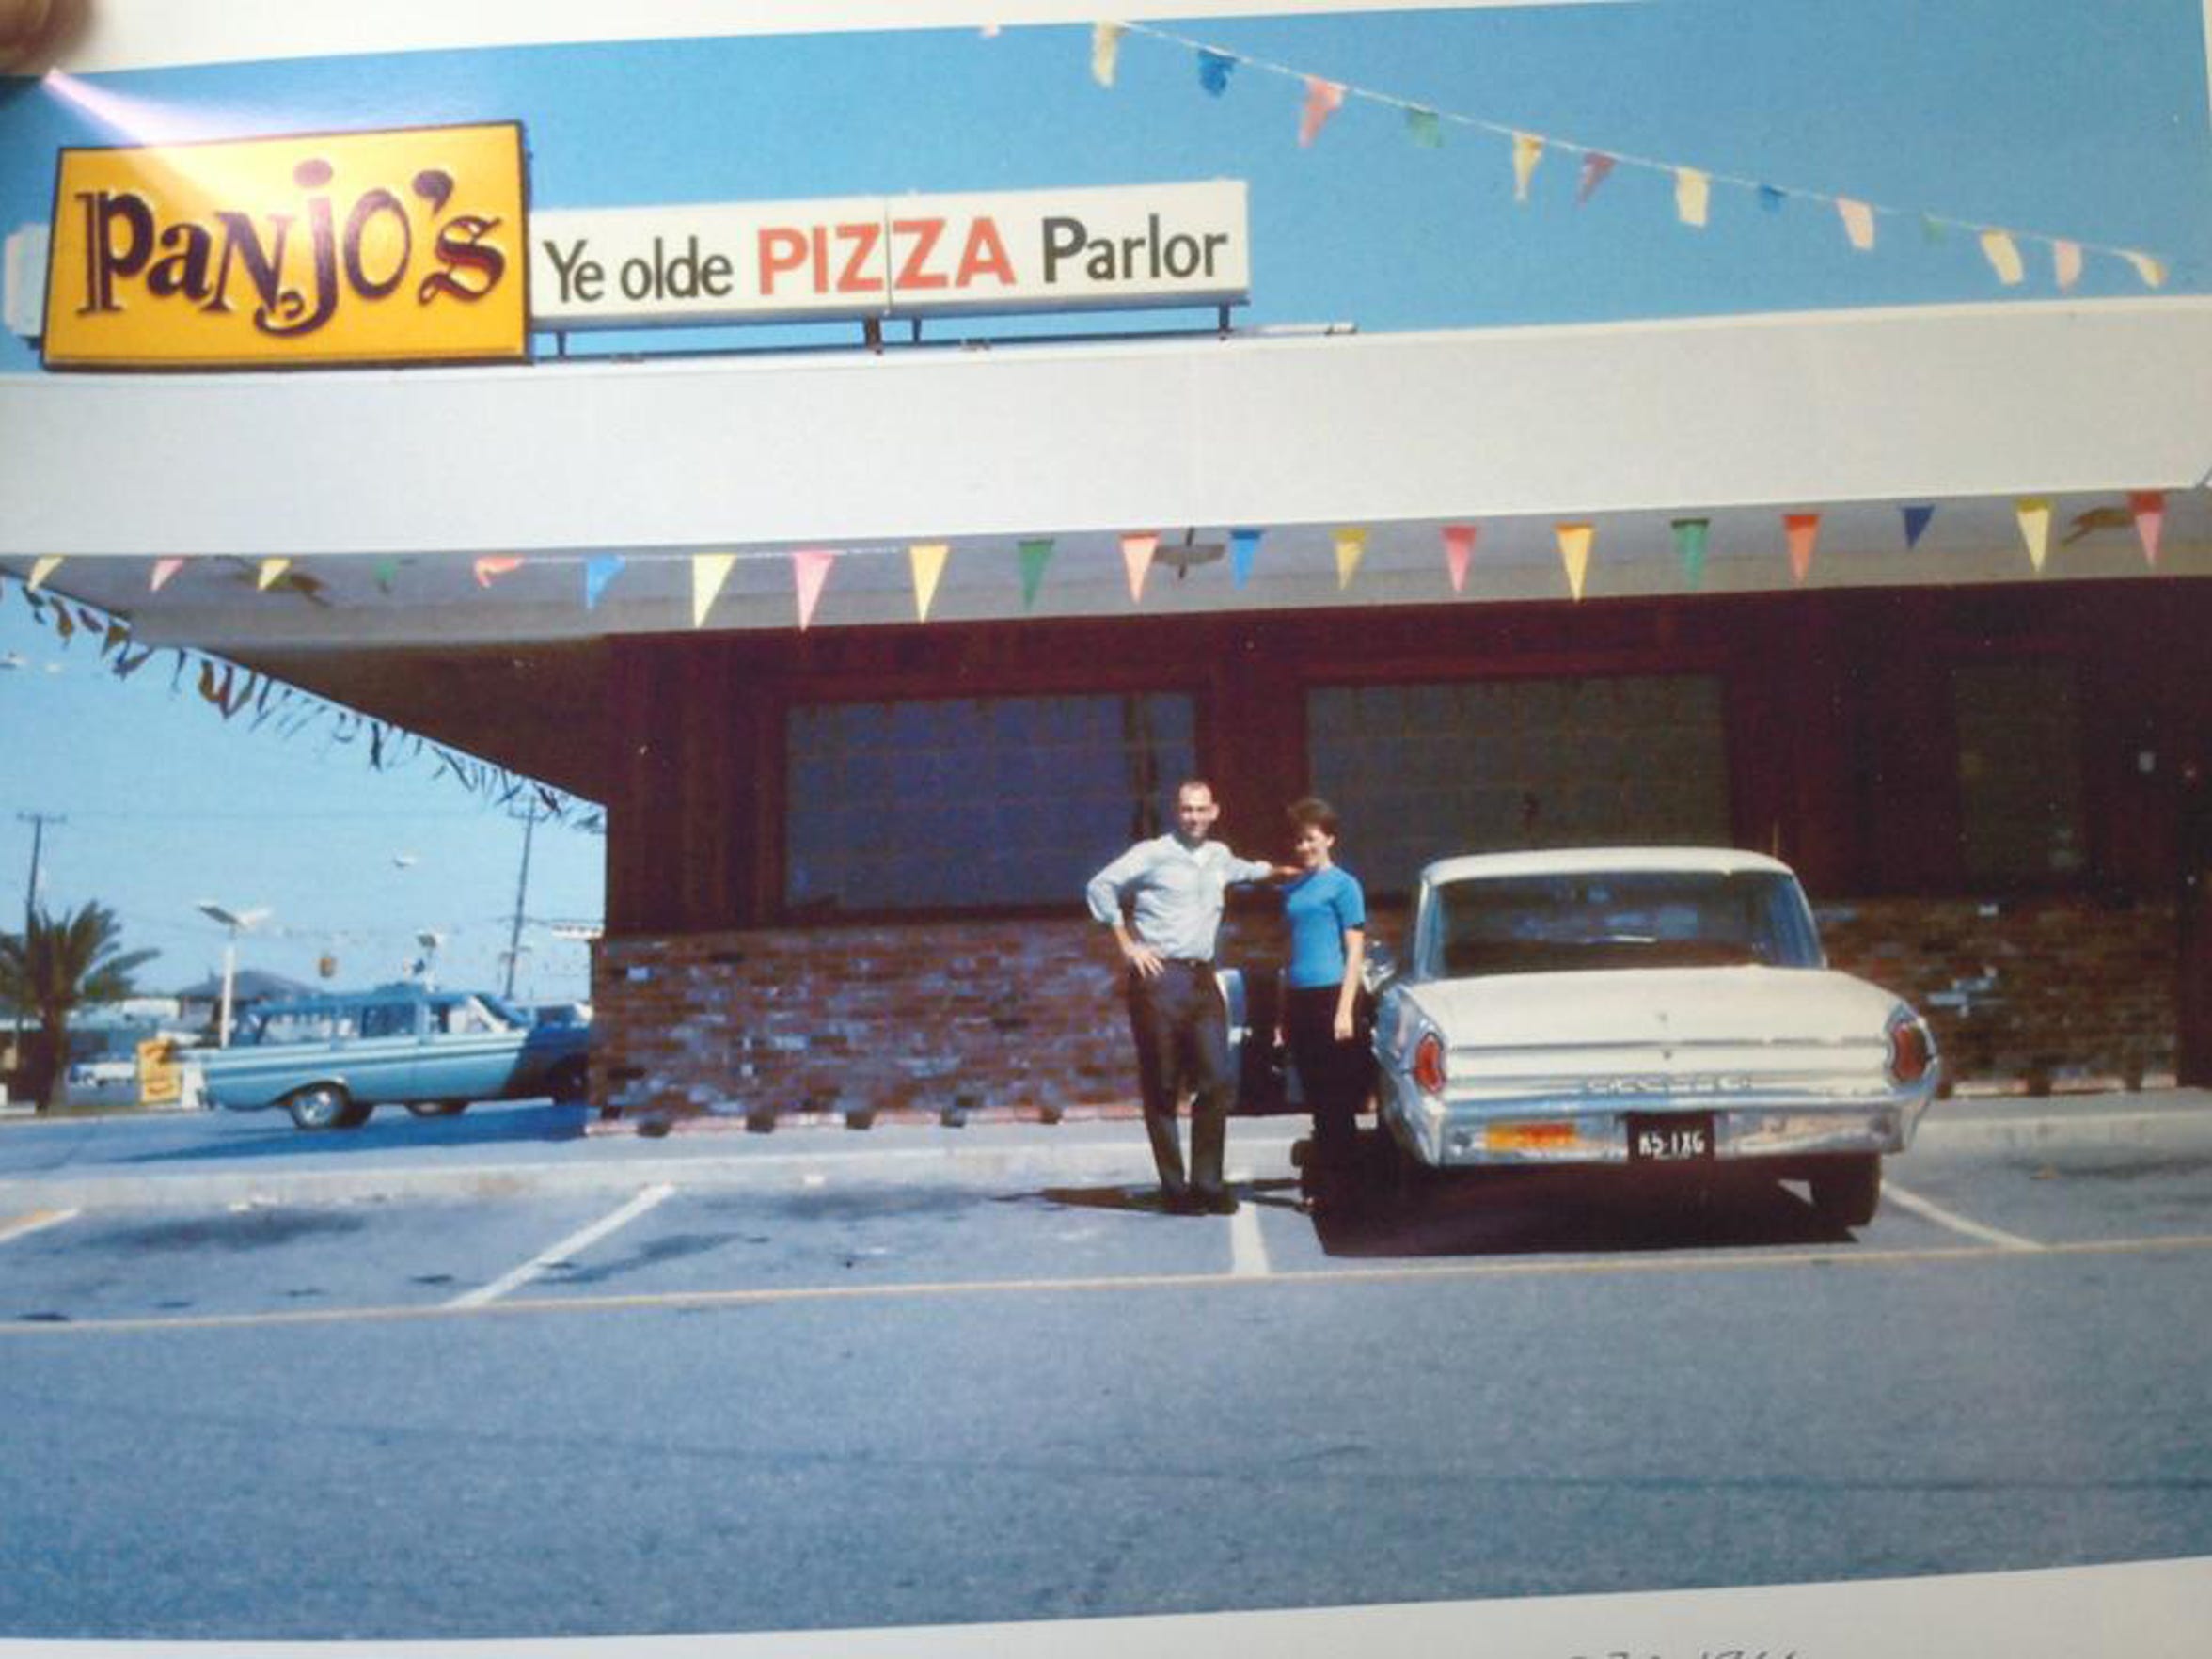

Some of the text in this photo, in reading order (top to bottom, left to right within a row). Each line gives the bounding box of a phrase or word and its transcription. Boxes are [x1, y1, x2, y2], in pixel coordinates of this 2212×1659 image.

[542, 213, 1228, 303] Ye olde PIZZA Parlor
